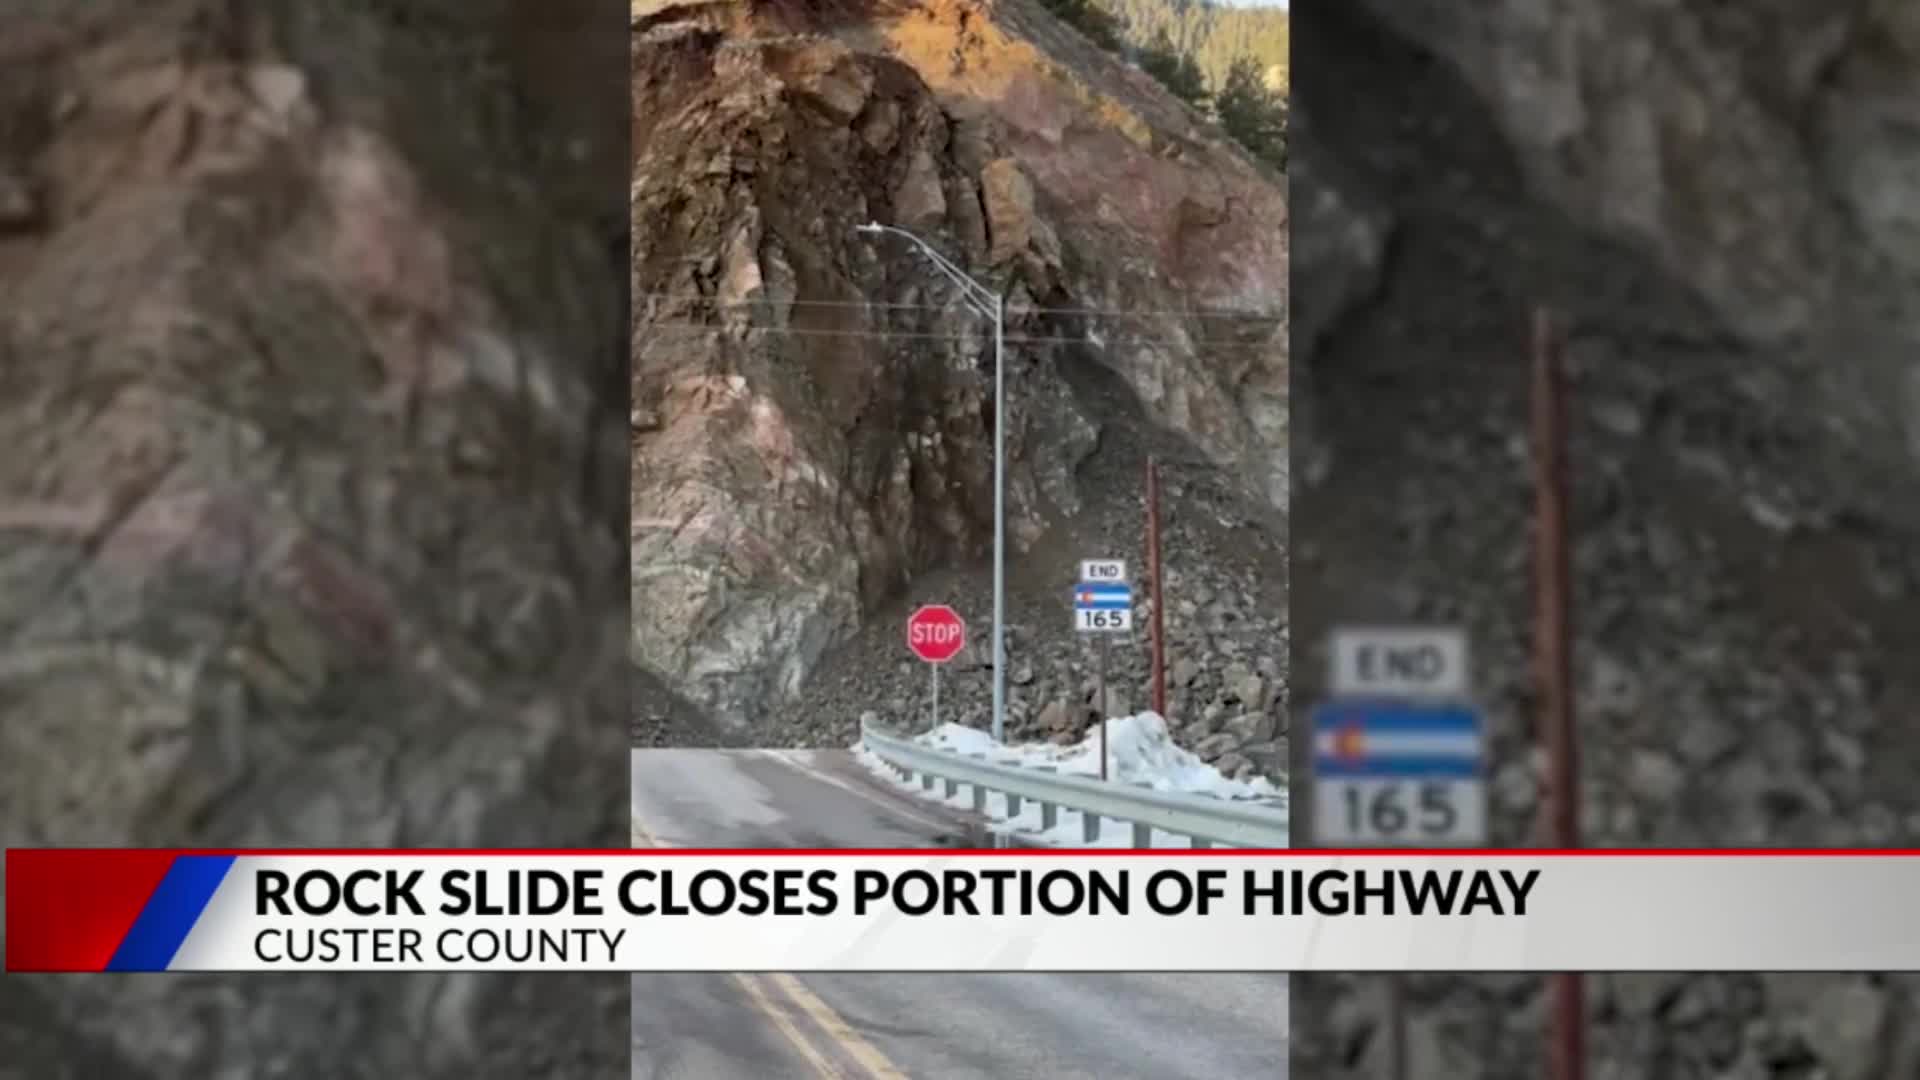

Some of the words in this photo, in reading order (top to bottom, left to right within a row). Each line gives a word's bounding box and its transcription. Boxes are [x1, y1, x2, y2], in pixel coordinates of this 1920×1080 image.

[1090, 564, 1119, 577] END
[1085, 611, 1122, 627] 165
[913, 623, 960, 643] STOP
[1356, 645, 1445, 681] END
[1344, 785, 1456, 834] 165
